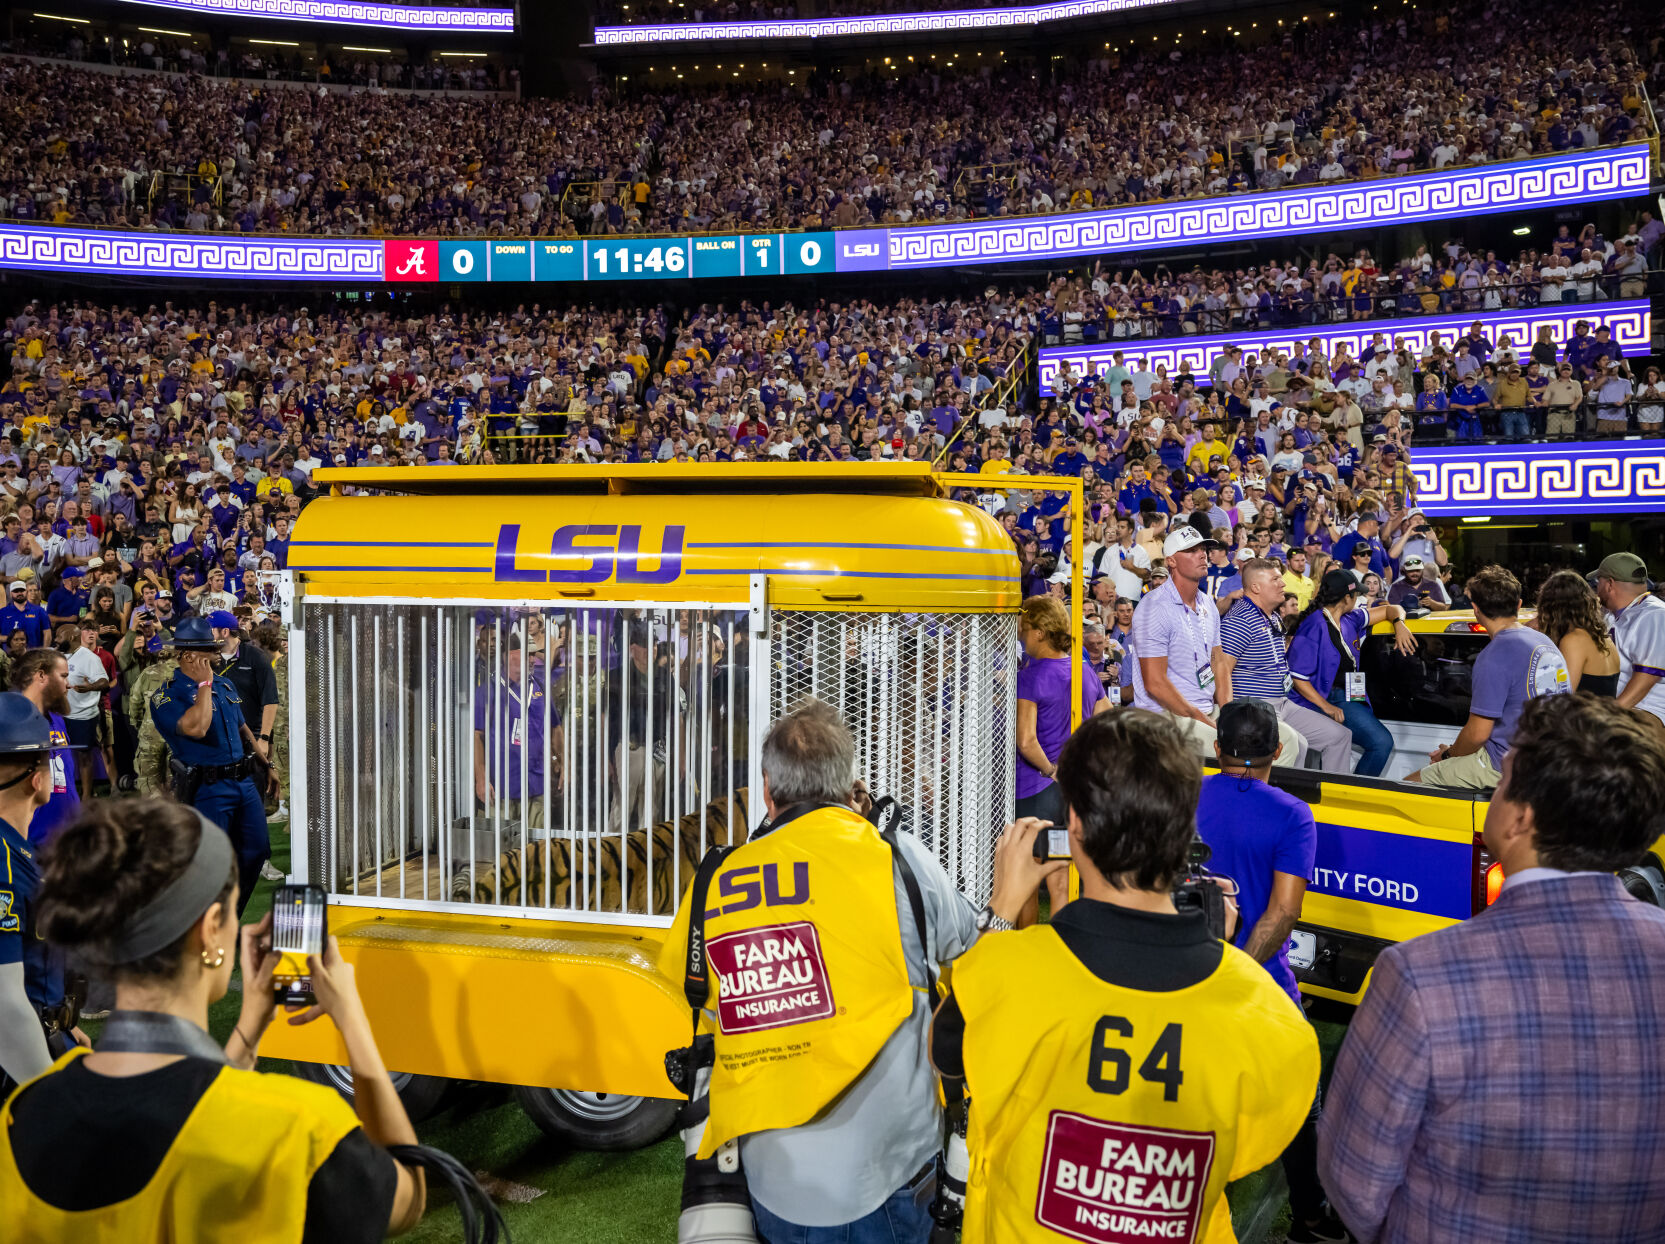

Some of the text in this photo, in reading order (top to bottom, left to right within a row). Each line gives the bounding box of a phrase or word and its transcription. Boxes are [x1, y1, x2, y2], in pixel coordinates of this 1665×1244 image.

[495, 245, 526, 254] DOWN
[544, 245, 574, 254] TO GO
[696, 240, 736, 250] BALL ON
[752, 238, 772, 248] QTR
[800, 240, 822, 267] 0
[843, 243, 880, 258] LSU
[452, 249, 474, 275] 0
[593, 246, 685, 273] 11:46
[756, 248, 768, 268] 1
[1062, 380, 1069, 391] 9
[914, 414, 922, 424] 9
[42, 550, 50, 566] 1
[494, 524, 686, 584] LSU
[704, 861, 810, 921] SU
[1310, 867, 1419, 904] ITY FORD
[691, 925, 701, 974] SONY
[733, 935, 808, 969] FARM
[719, 958, 814, 998] BUREAU
[735, 990, 821, 1019] INSURANCE
[734, 1047, 782, 1060] PHOTOGRAPHER
[787, 1043, 802, 1051] NON
[769, 1054, 788, 1062] WORN
[1086, 1014, 1184, 1103] 64
[1100, 1137, 1196, 1179] FARM
[1055, 1158, 1195, 1211] BUREAU
[1075, 1205, 1188, 1239] INSURANCE
